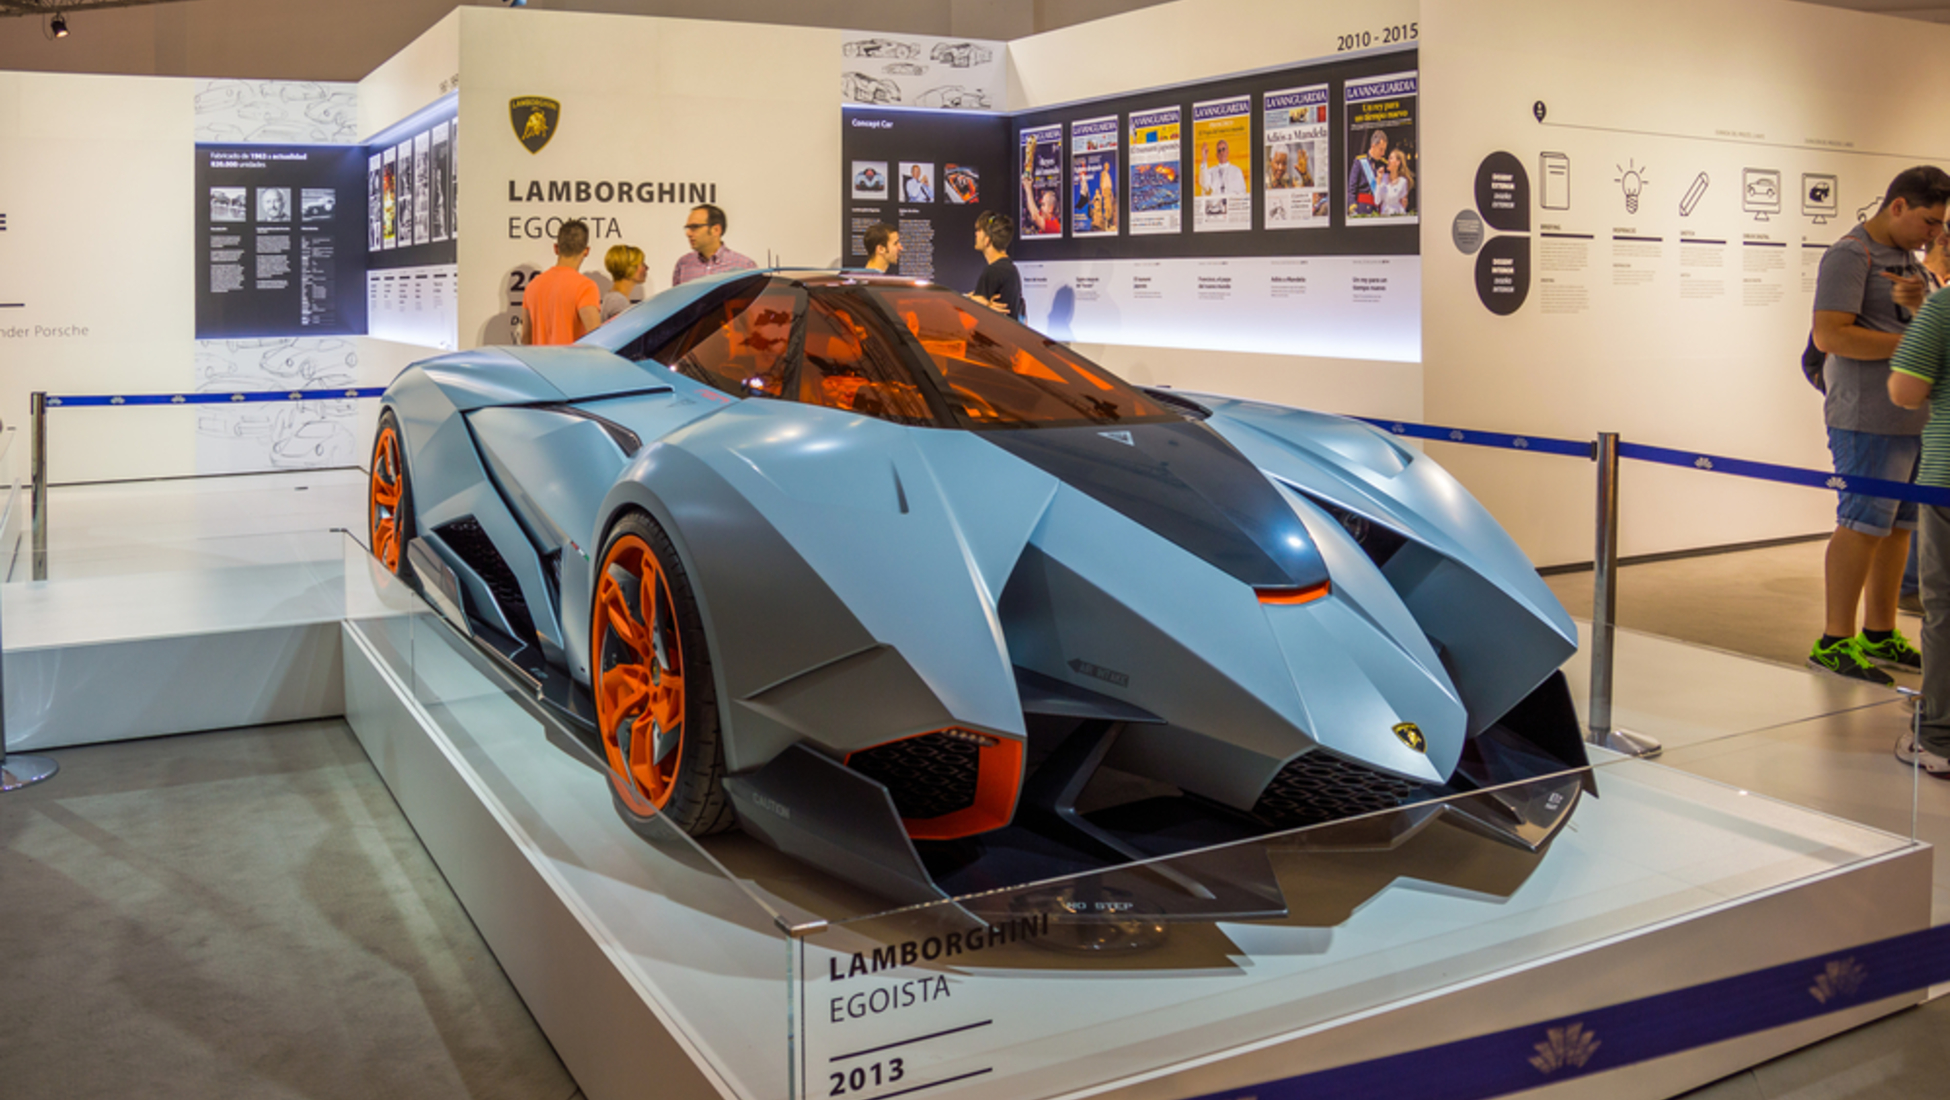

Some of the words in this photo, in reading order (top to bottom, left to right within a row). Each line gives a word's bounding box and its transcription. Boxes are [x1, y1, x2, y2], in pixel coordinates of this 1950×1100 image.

[1337, 30, 1371, 52] 2010
[1382, 22, 1419, 43] 2015
[852, 118, 880, 129] Concept
[881, 119, 894, 129] Car
[508, 180, 717, 203] LAMBORGHINI
[509, 216, 622, 239] EGOTA
[34, 323, 90, 338] Porsche
[1066, 901, 1087, 910] NO
[1094, 901, 1134, 911] STEP
[829, 912, 1049, 982] LAMBORGHINI
[830, 974, 951, 1024] EGOISTA
[829, 1057, 904, 1097] 2013
